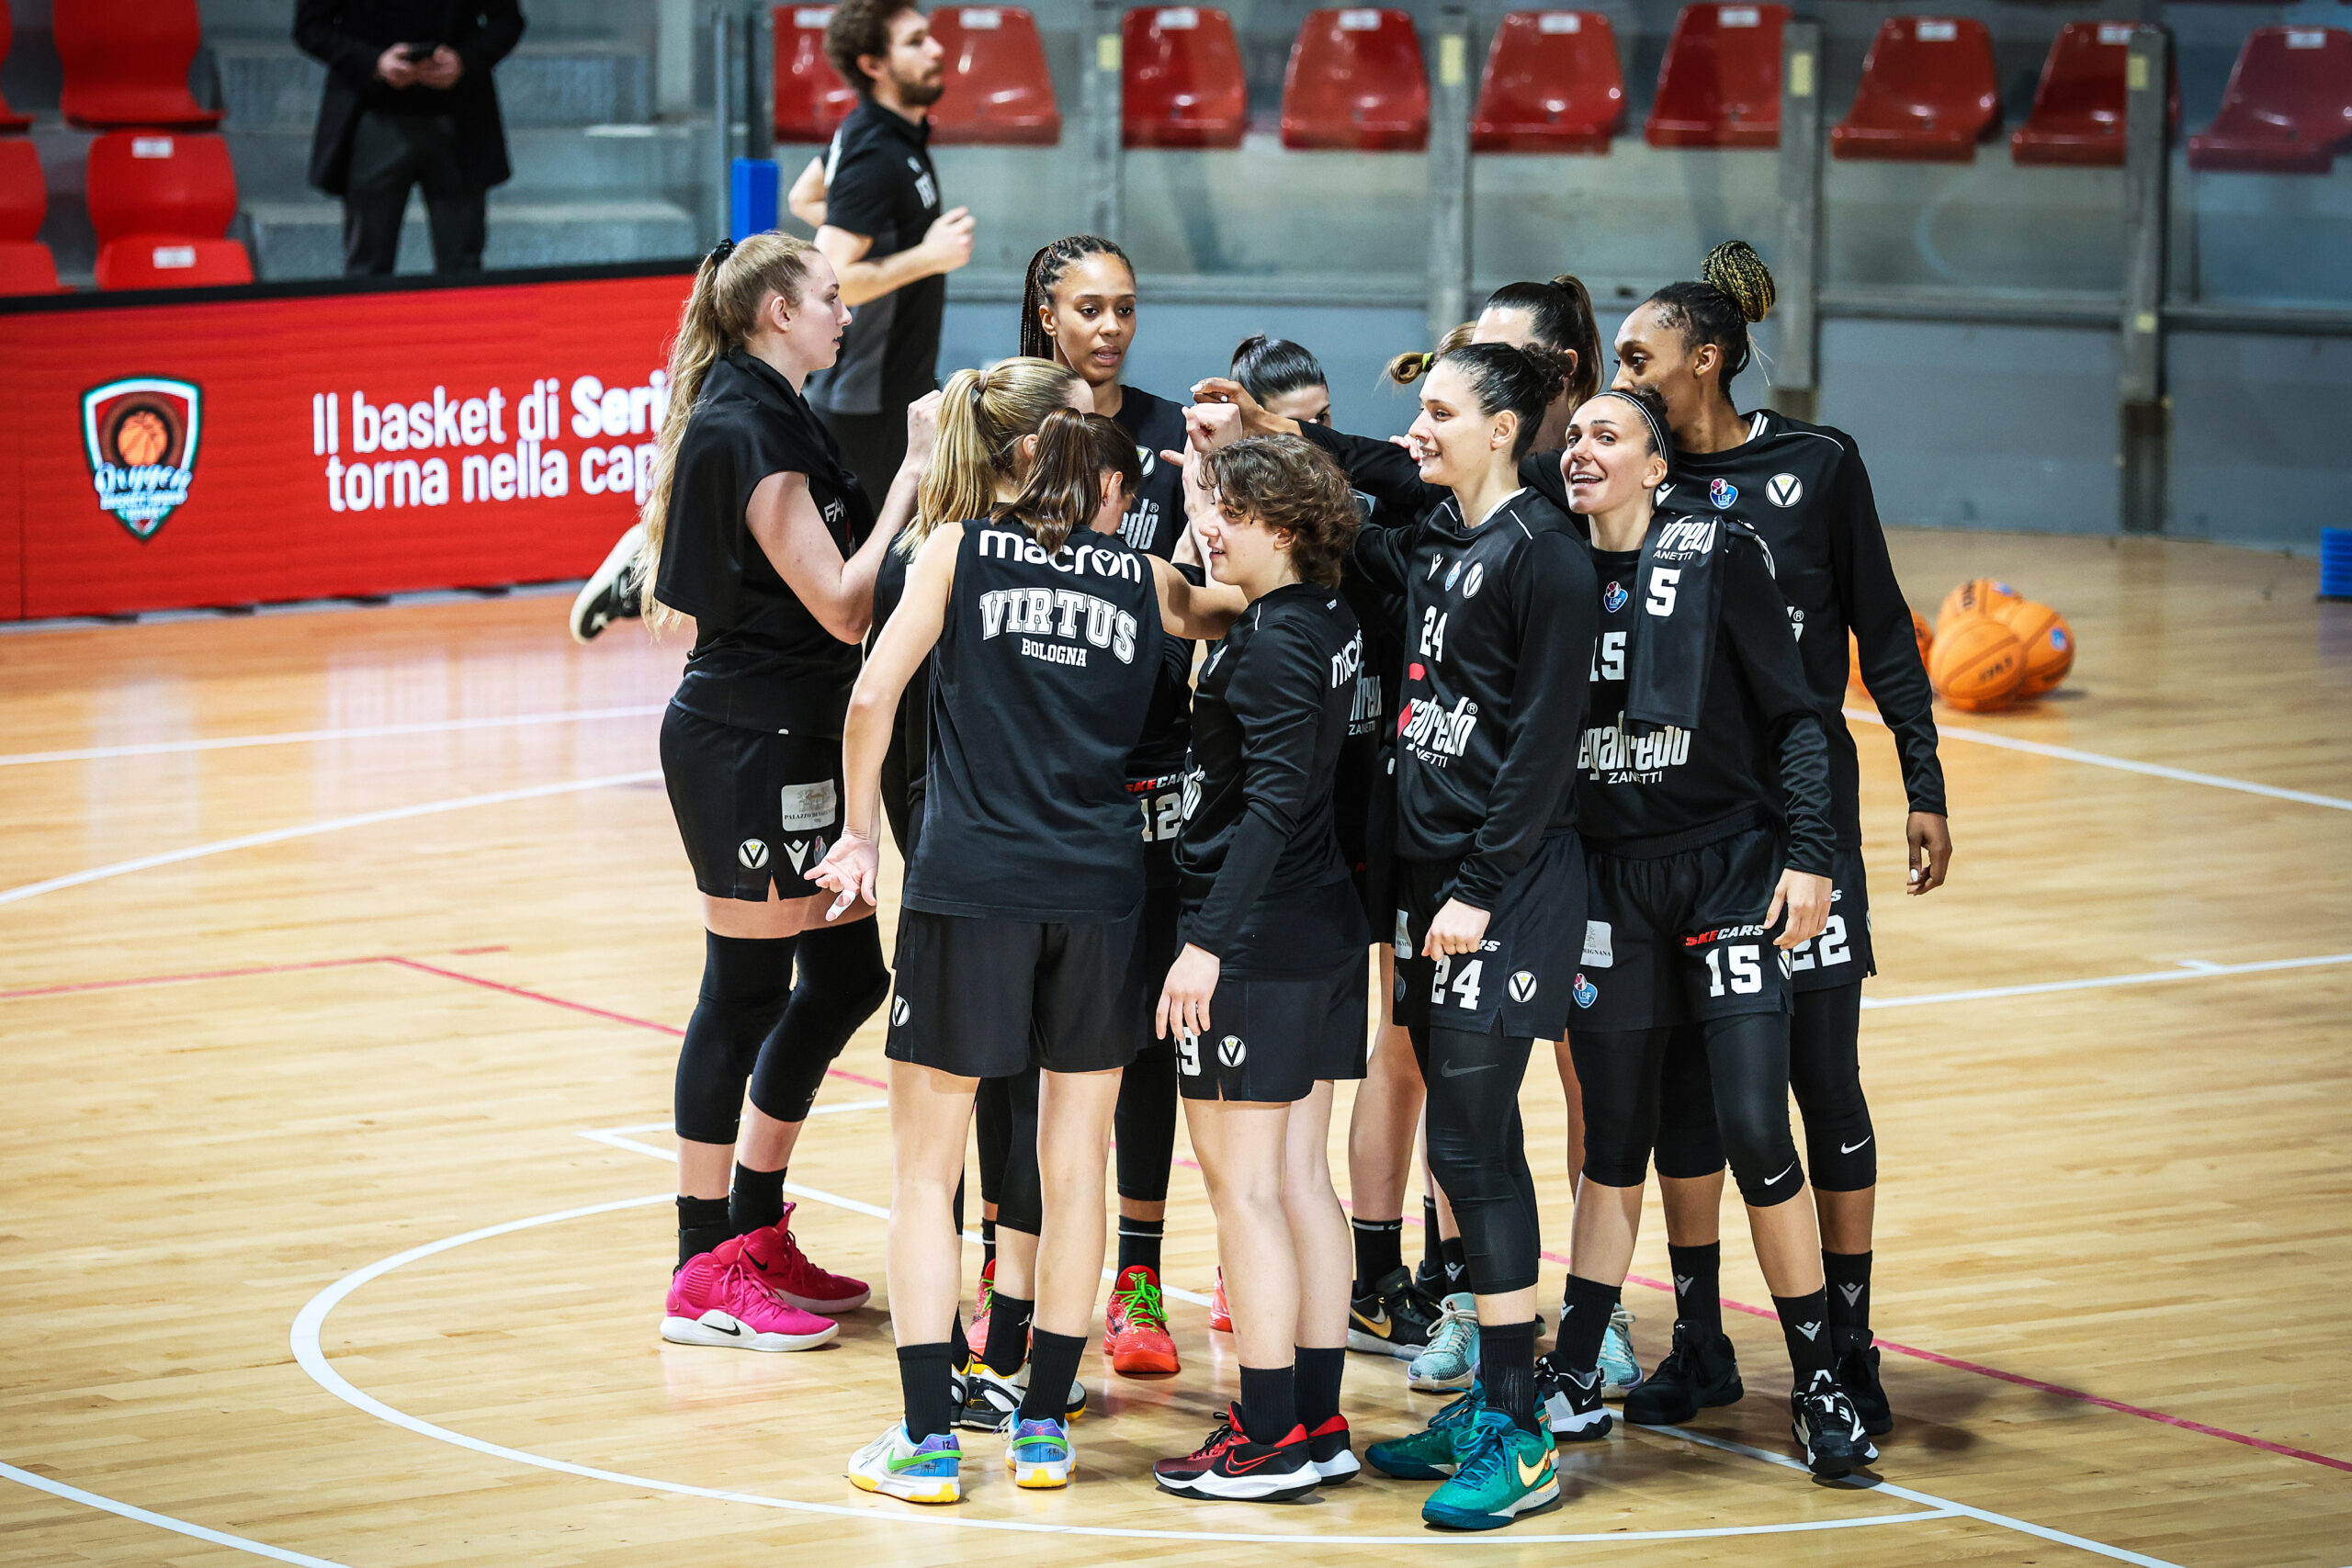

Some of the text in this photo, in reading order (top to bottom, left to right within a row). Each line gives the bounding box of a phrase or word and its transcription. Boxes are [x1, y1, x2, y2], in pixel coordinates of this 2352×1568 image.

[312, 392, 339, 456] Il
[352, 385, 507, 454] basket
[517, 378, 560, 441] di
[325, 455, 449, 513] torna
[462, 438, 569, 502] nella
[979, 529, 1141, 583] macron
[1645, 567, 1681, 616] 5
[979, 588, 1137, 664] VIRTUS
[1021, 638, 1087, 667] BOLOGNA
[1419, 605, 1448, 663] 24
[1608, 770, 1662, 784] ZANETTI
[1140, 792, 1182, 842] 12
[1685, 924, 1764, 947] SKECARS
[1431, 955, 1484, 1010] 24
[1705, 944, 1762, 997] 15
[1174, 1026, 1201, 1077] 9
